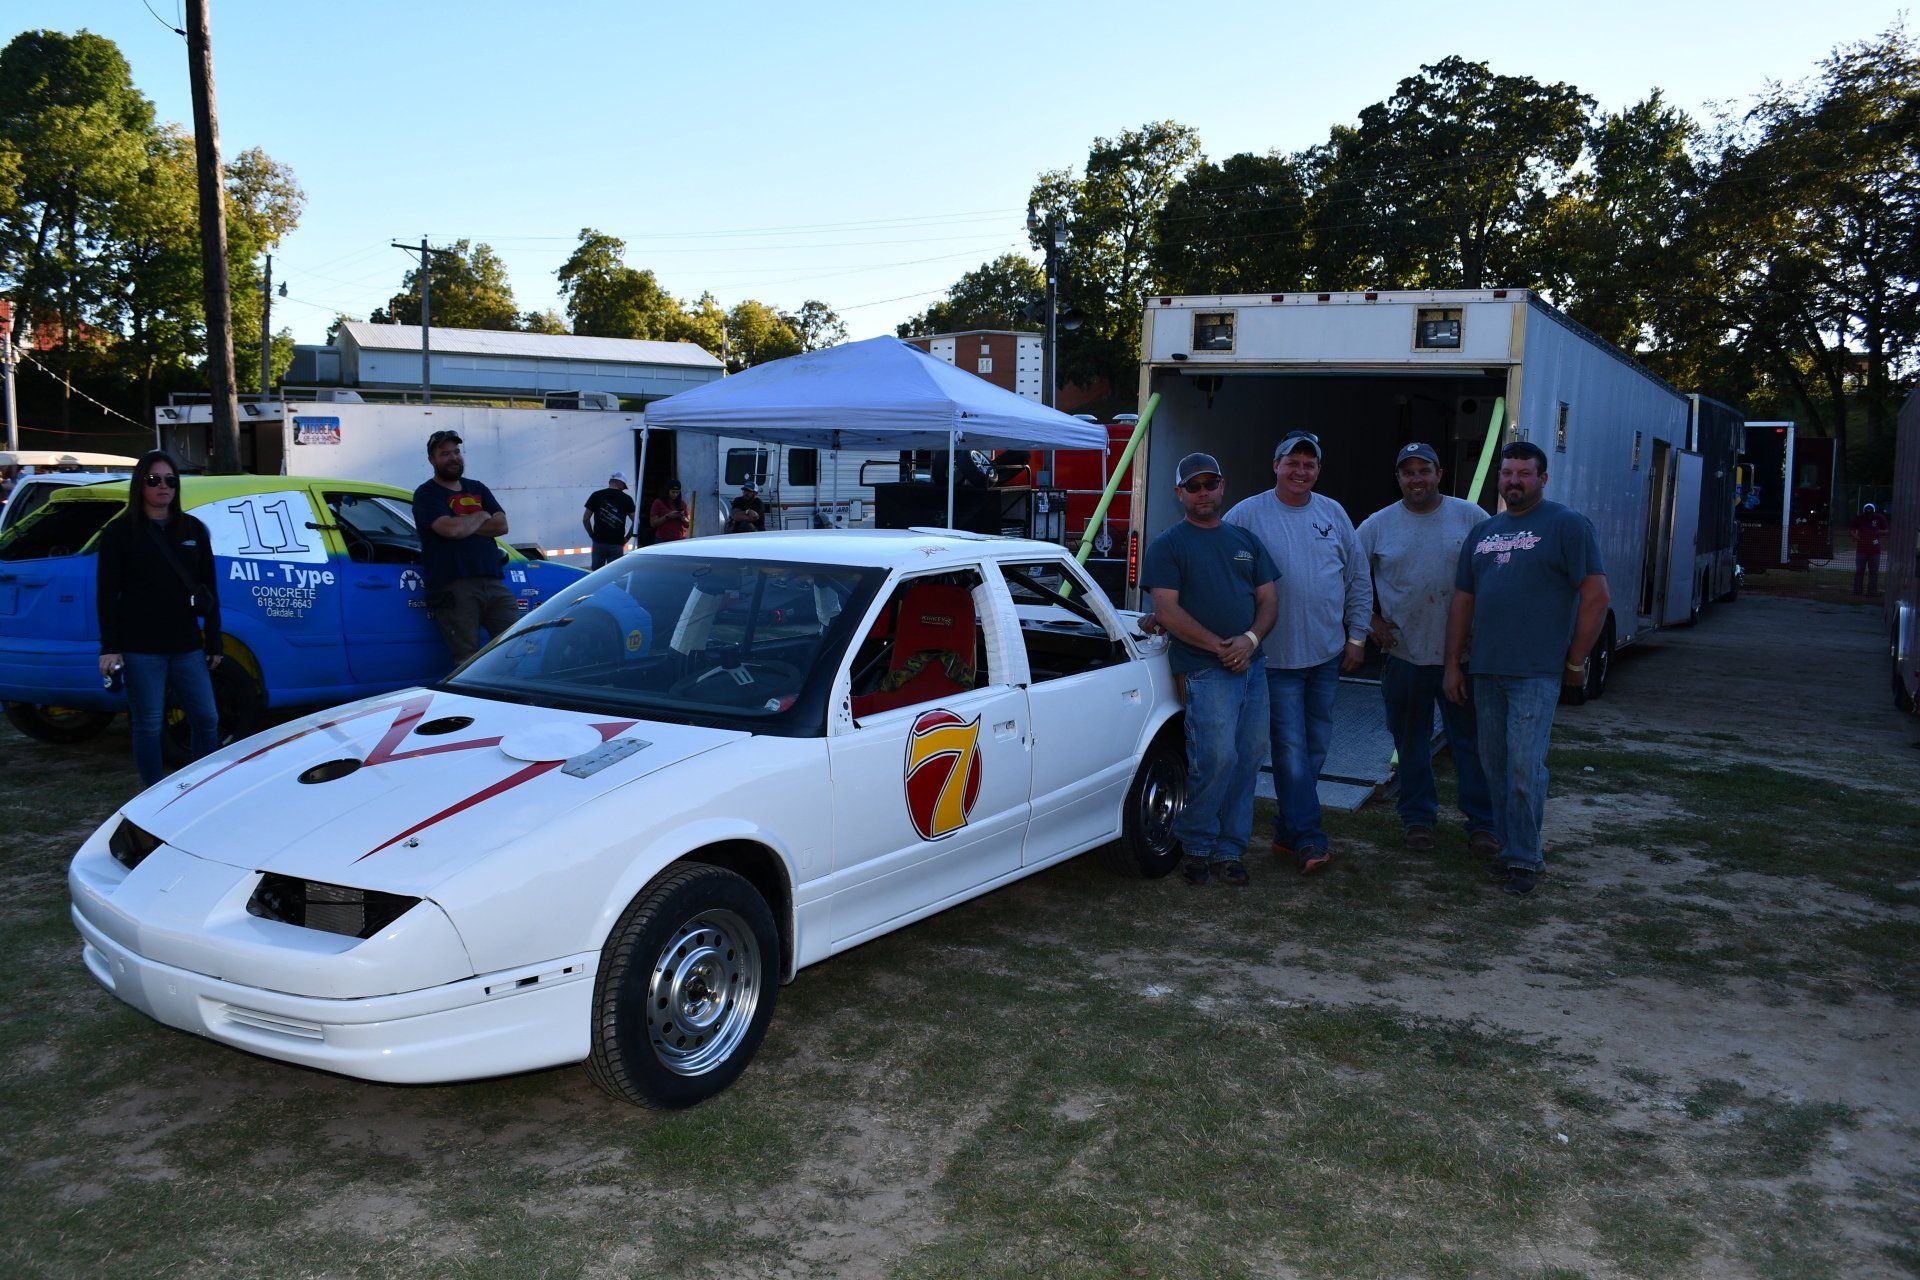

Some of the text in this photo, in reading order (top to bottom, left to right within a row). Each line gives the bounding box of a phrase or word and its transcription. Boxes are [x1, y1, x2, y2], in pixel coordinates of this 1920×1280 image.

[228, 500, 310, 554] 11
[229, 561, 260, 581] All
[279, 564, 335, 589] Type
[251, 586, 317, 599] CONCRETE
[257, 597, 312, 609] 618-327-6643
[297, 609, 304, 618] IL
[907, 712, 981, 837] 7
